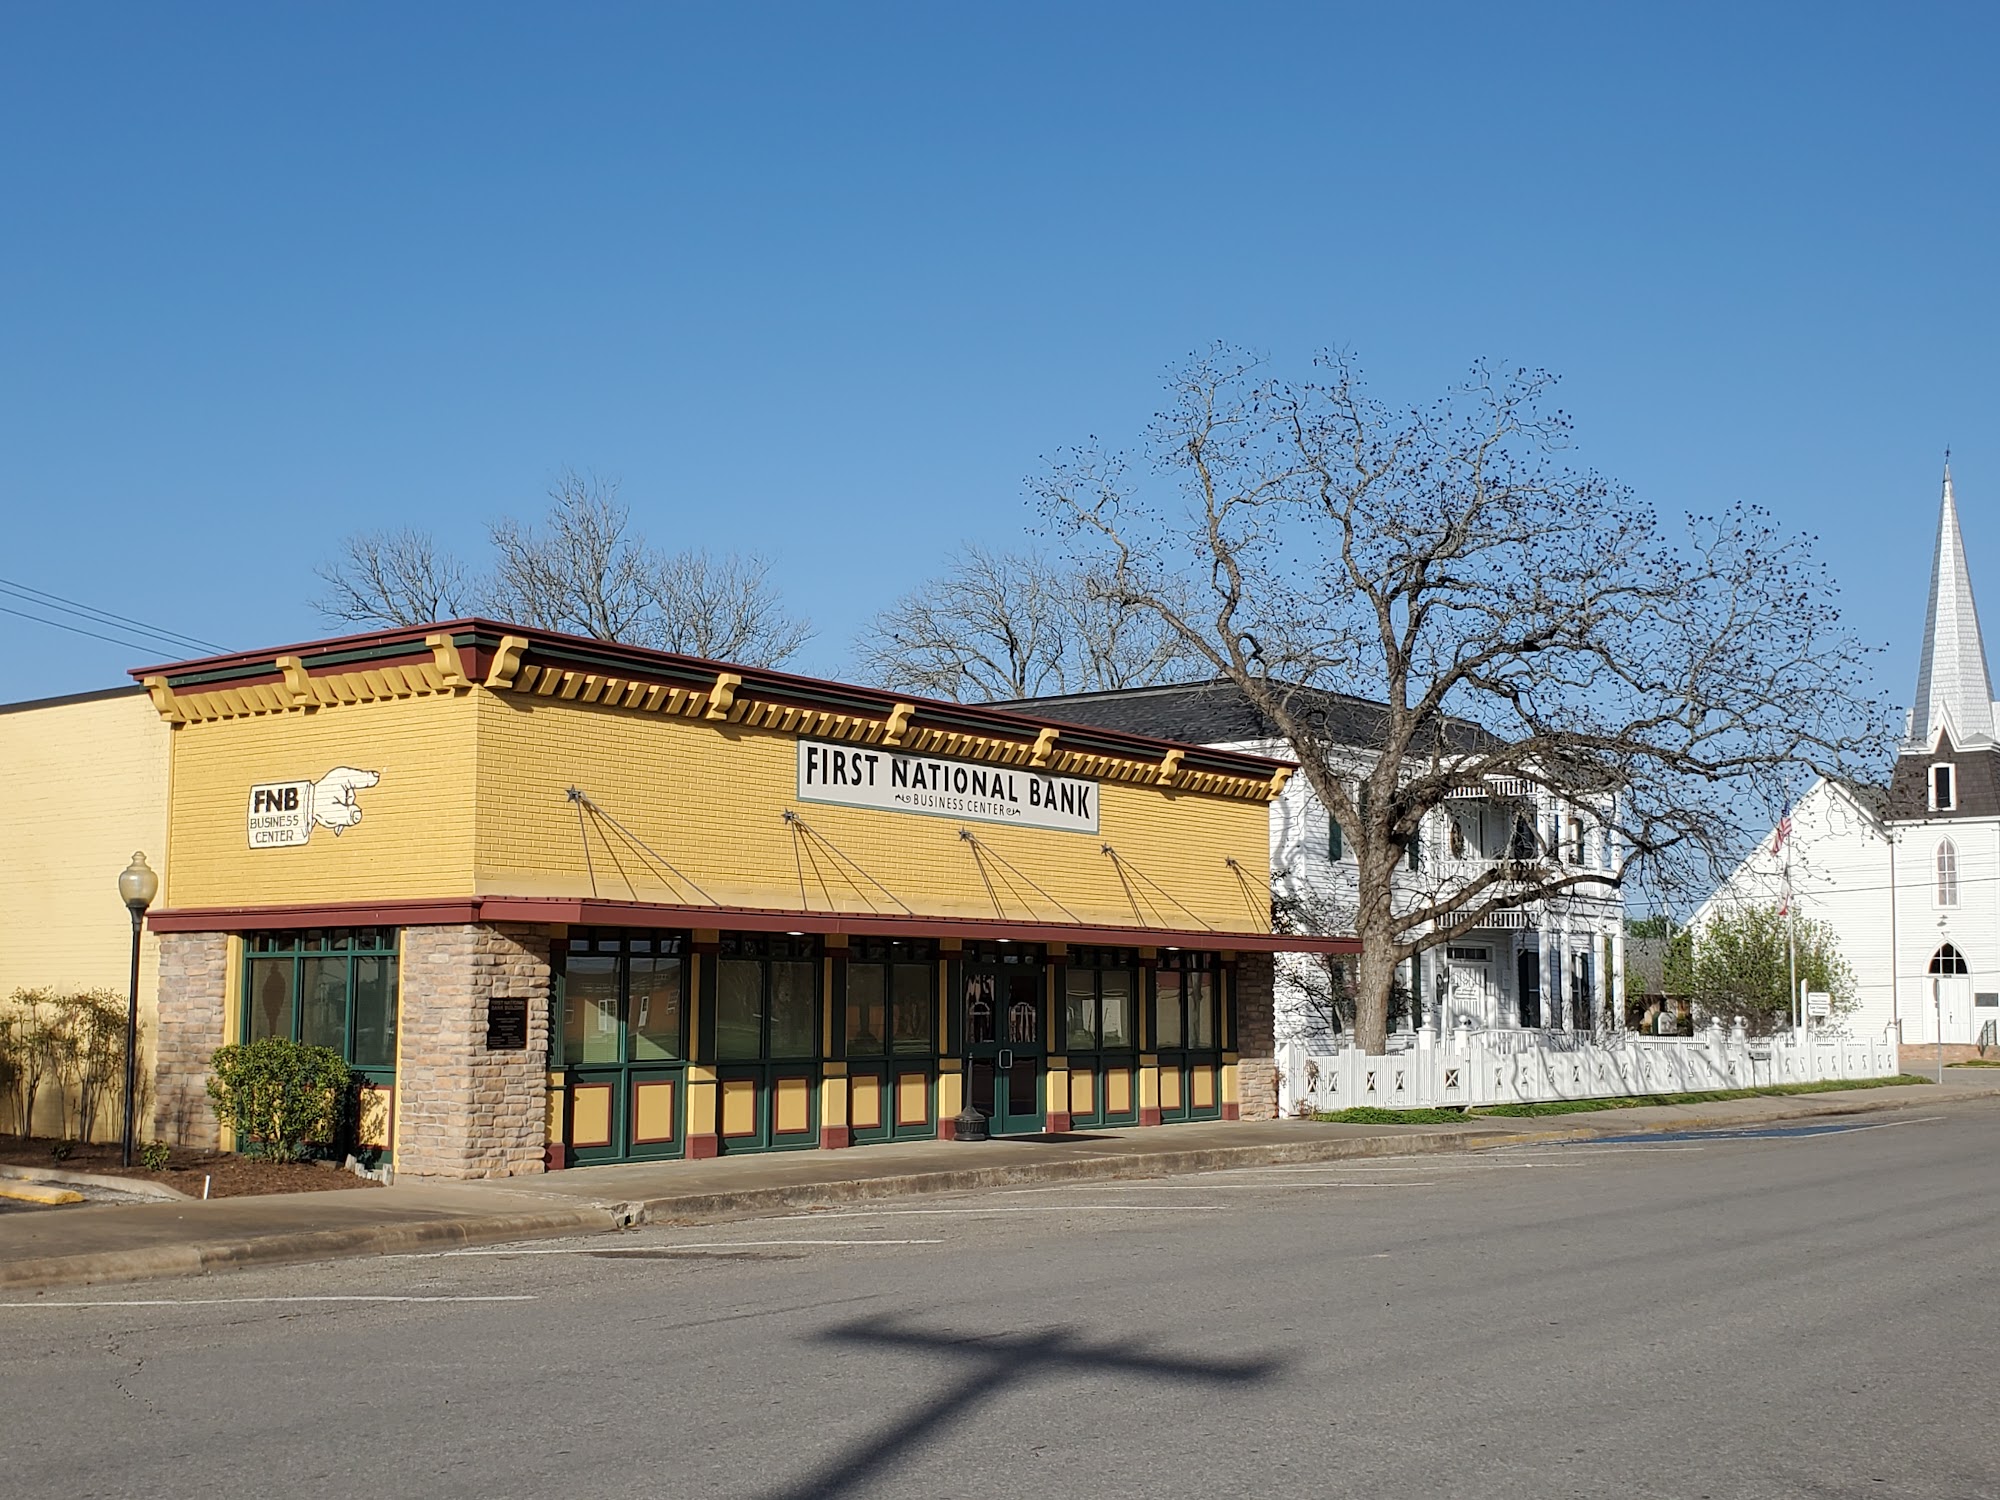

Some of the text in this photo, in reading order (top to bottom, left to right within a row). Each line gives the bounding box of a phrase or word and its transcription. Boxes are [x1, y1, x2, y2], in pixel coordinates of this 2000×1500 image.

[806, 747, 1090, 819] FIRST NATIONAL BANK
[254, 788, 299, 813] FNB
[913, 793, 1005, 816] BUSINESS CENTER
[250, 815, 299, 829] BUSINESS
[255, 830, 294, 843] CENTER
